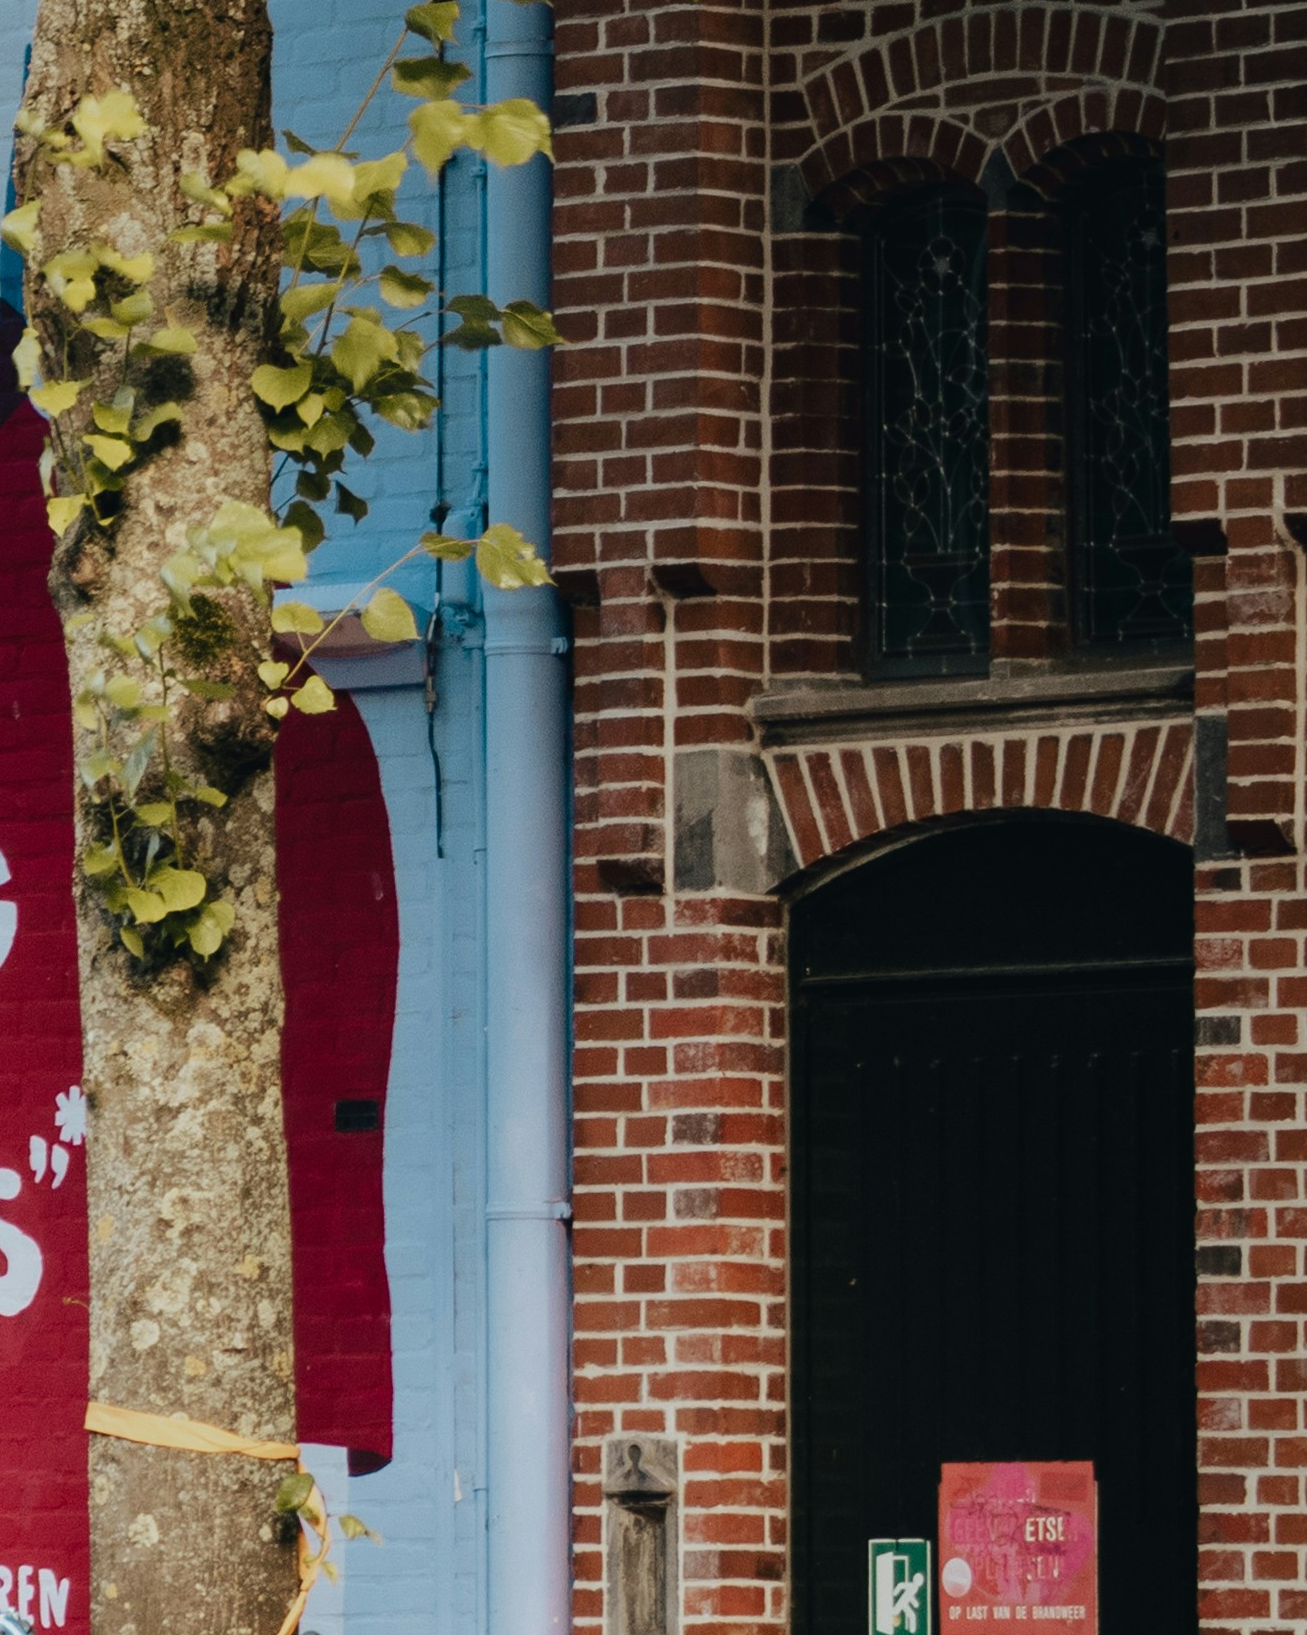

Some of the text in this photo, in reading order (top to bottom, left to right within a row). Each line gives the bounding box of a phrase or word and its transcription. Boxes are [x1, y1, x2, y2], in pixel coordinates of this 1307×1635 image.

[948, 1605, 1086, 1621] OP LAST VAN DE BRANDWEER
